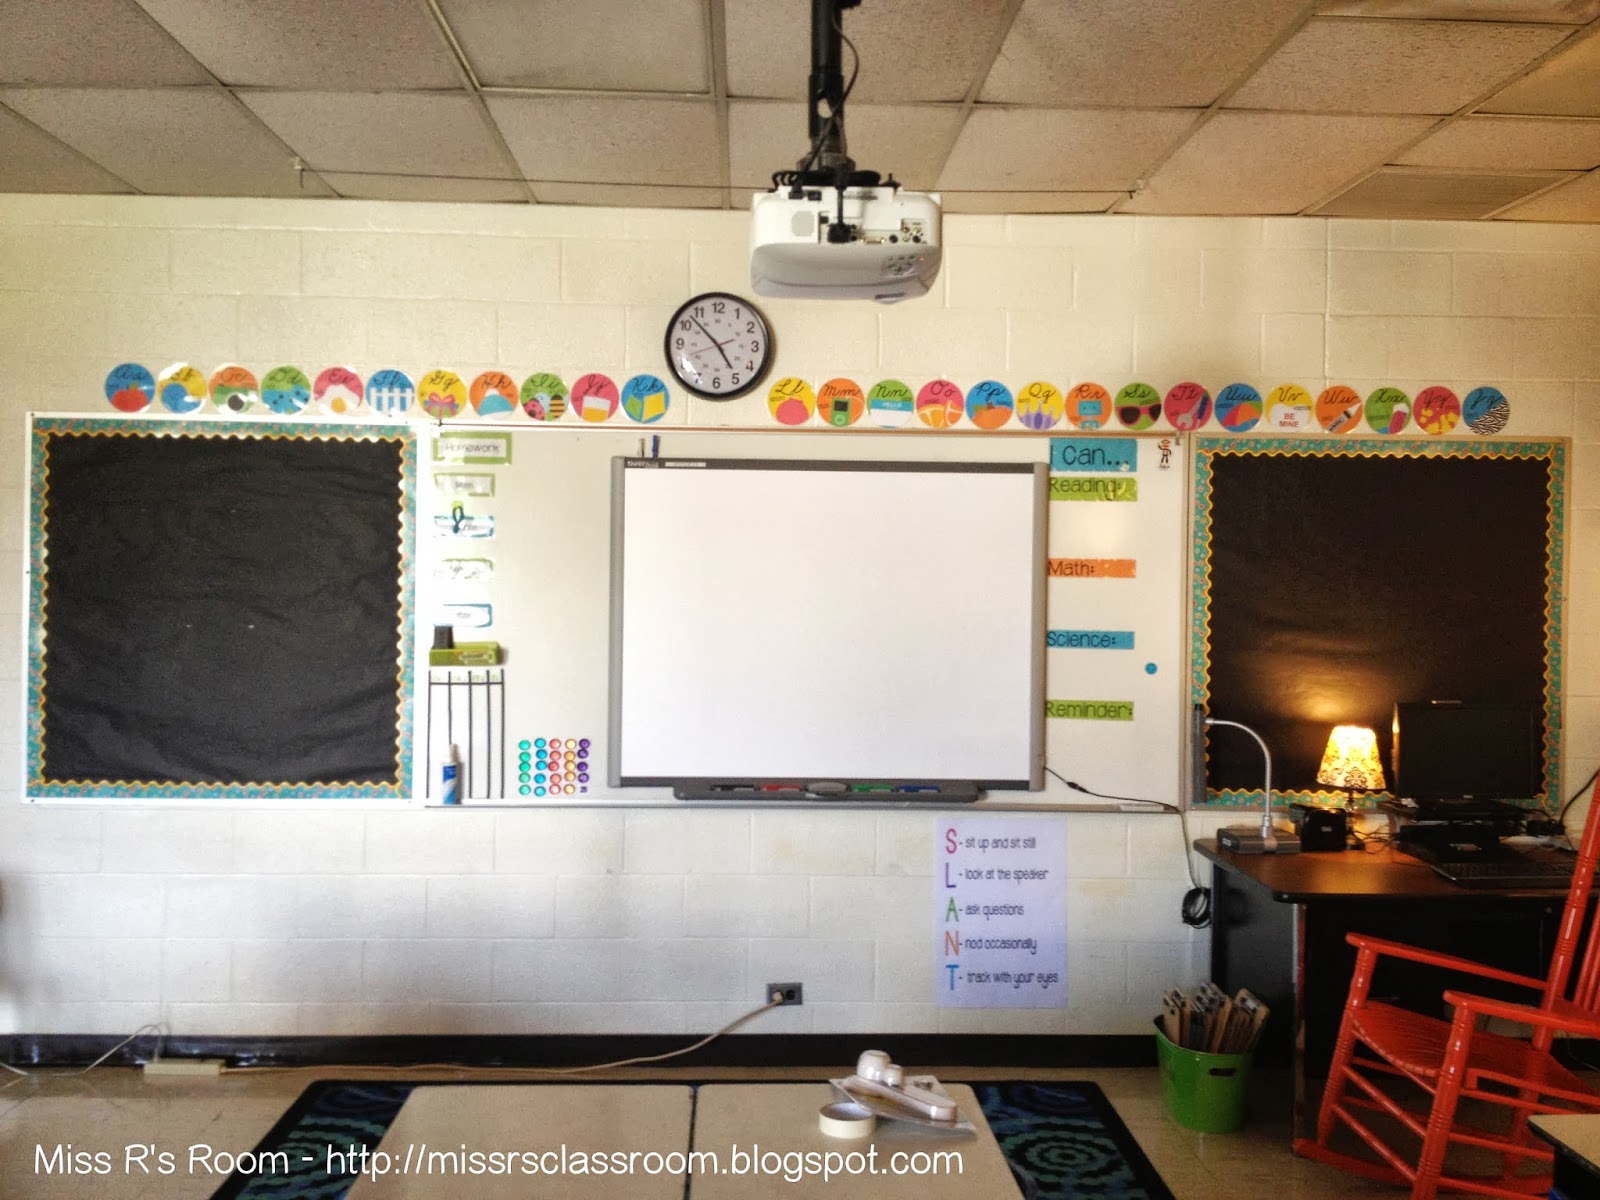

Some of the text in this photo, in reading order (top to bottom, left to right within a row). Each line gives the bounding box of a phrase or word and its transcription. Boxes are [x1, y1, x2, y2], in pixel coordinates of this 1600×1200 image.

[694, 306, 704, 318] 11
[712, 302, 725, 314] 12
[734, 308, 740, 320] 1
[681, 320, 692, 331] 10
[746, 321, 755, 334] 2
[676, 338, 685, 350] 9
[751, 340, 759, 353] 3
[746, 360, 754, 372] 4
[712, 377, 721, 389] 6
[731, 373, 740, 385] 5
[1283, 412, 1296, 420] BE
[1046, 630, 1116, 649] Science:
[965, 837, 976, 848] sit
[978, 838, 990, 853] up
[991, 837, 1009, 848] and
[1010, 837, 1021, 848] sit
[965, 868, 983, 880] look
[985, 868, 995, 880] at
[997, 868, 1011, 880] the
[1013, 868, 1049, 885] speaker
[965, 904, 980, 915] ask
[982, 904, 1024, 920] questions
[965, 938, 983, 949] nod
[984, 938, 1037, 955] occasionally
[967, 971, 991, 983] track
[993, 971, 1012, 983] with
[1013, 972, 1035, 989] your
[1037, 972, 1058, 989] eyes
